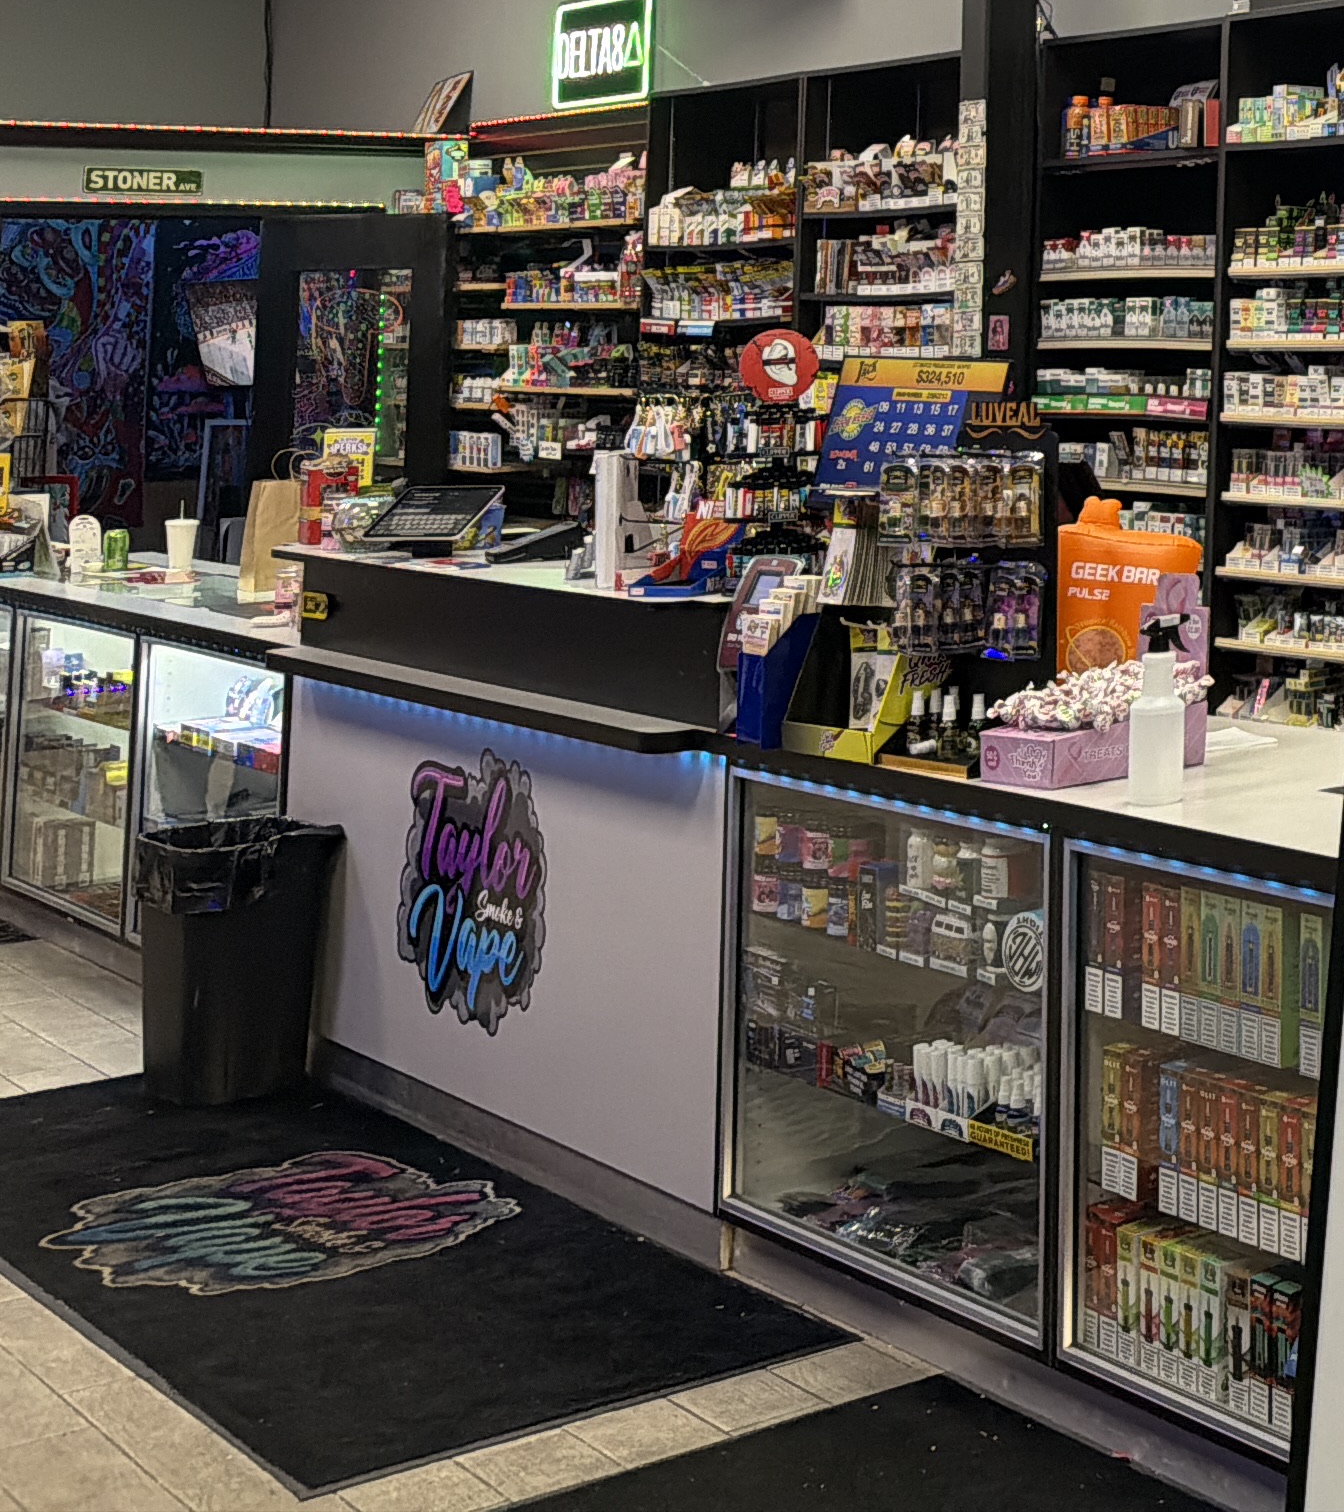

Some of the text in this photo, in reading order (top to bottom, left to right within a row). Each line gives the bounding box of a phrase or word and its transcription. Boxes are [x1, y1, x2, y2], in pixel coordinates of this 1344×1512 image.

[90, 171, 197, 192] STONER AVE
[915, 370, 965, 385] $324,510
[878, 402, 959, 416] 09 11 13 15 17
[971, 401, 1040, 426] LUVEAL
[873, 421, 953, 436] 24 27 28 36 37
[863, 461, 874, 472] 61
[1071, 561, 1161, 586] GEEK BAR
[1067, 587, 1111, 601] PULSE
[1083, 747, 1124, 760] TREATS
[414, 770, 537, 914] Taylor
[475, 889, 523, 929] Smoke &
[410, 884, 524, 1010] Vape
